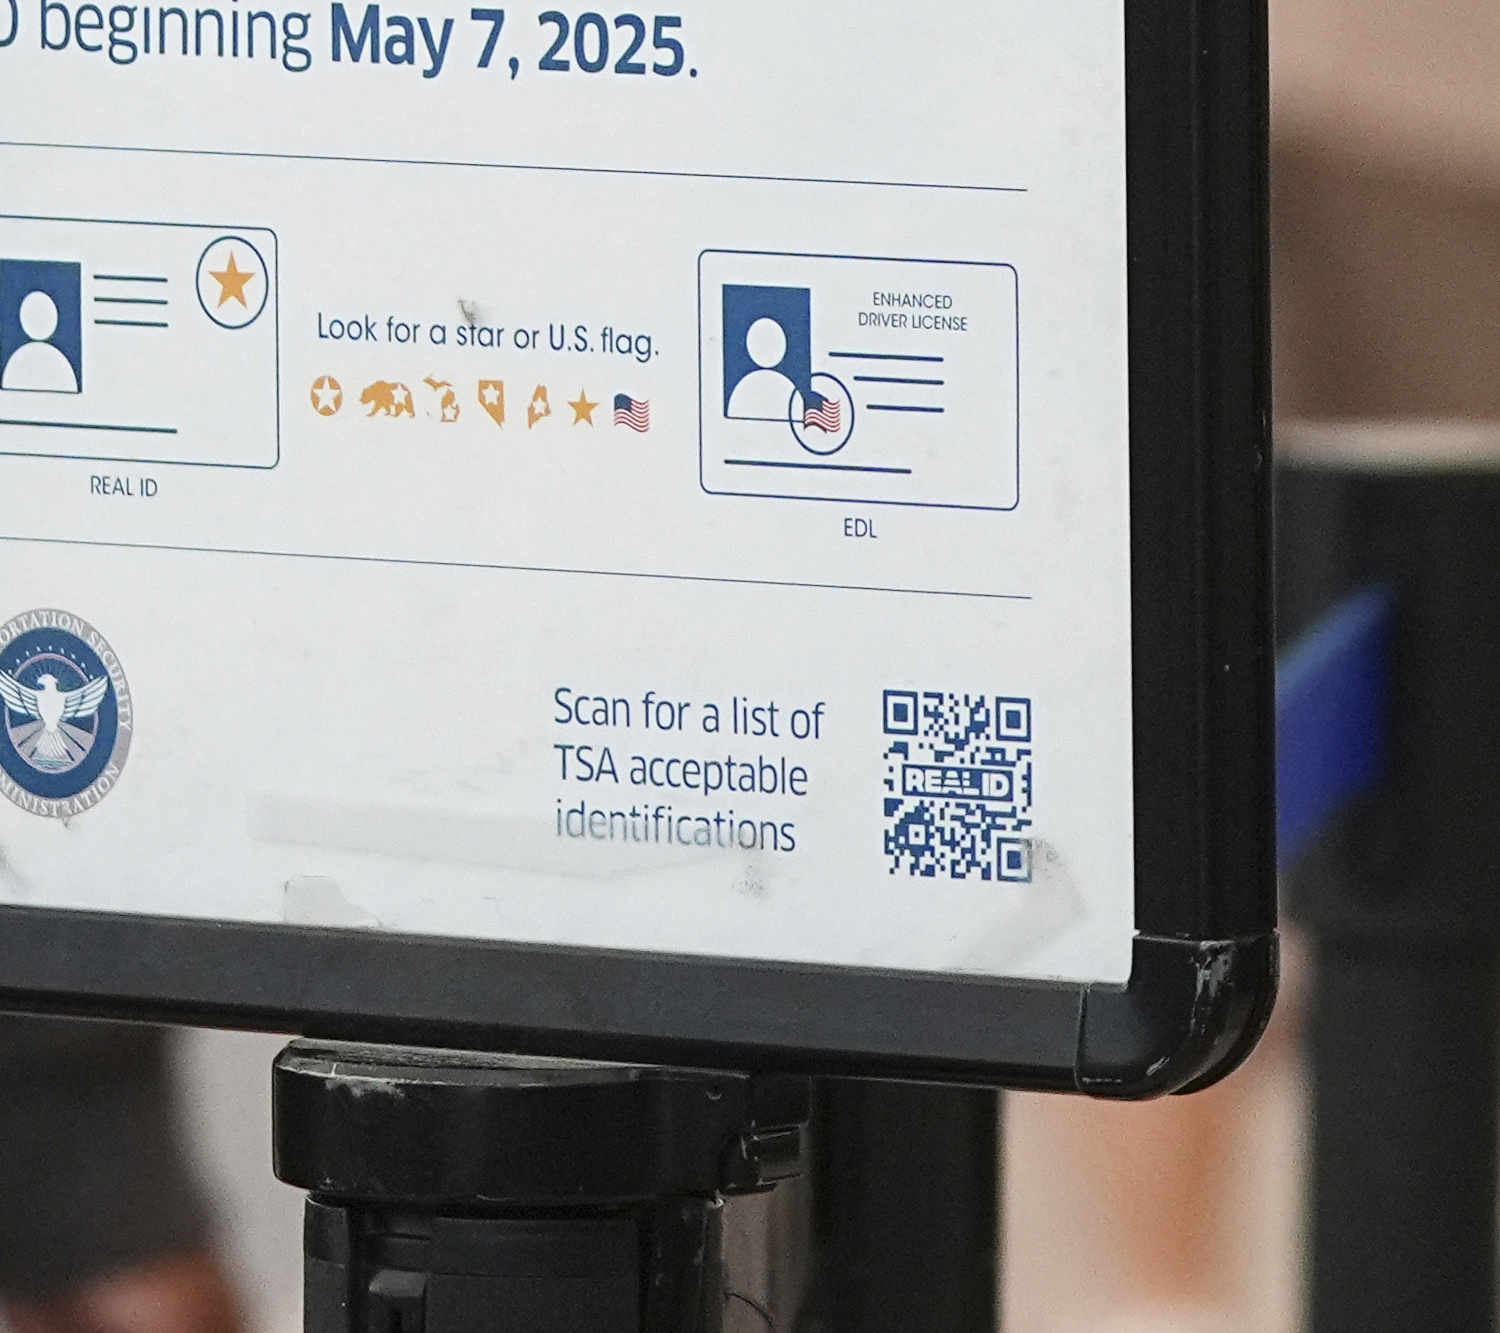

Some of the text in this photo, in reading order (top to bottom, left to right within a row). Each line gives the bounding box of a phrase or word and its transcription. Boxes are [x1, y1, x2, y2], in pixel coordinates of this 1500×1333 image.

[330, 1, 455, 79] May
[470, 7, 520, 81] 7,
[537, 10, 698, 78] 2025.
[873, 291, 953, 310] ENHANCED
[318, 312, 660, 364] Look for a star or U.S. flag.
[858, 311, 968, 332] DRIVER LICENSE
[90, 475, 158, 498] REAL ID
[843, 517, 878, 539] EDL
[554, 686, 826, 740] Scan for a list of
[553, 743, 808, 797] TSA acceptable
[905, 768, 1010, 797] REAL ID
[556, 798, 796, 853] identifications
